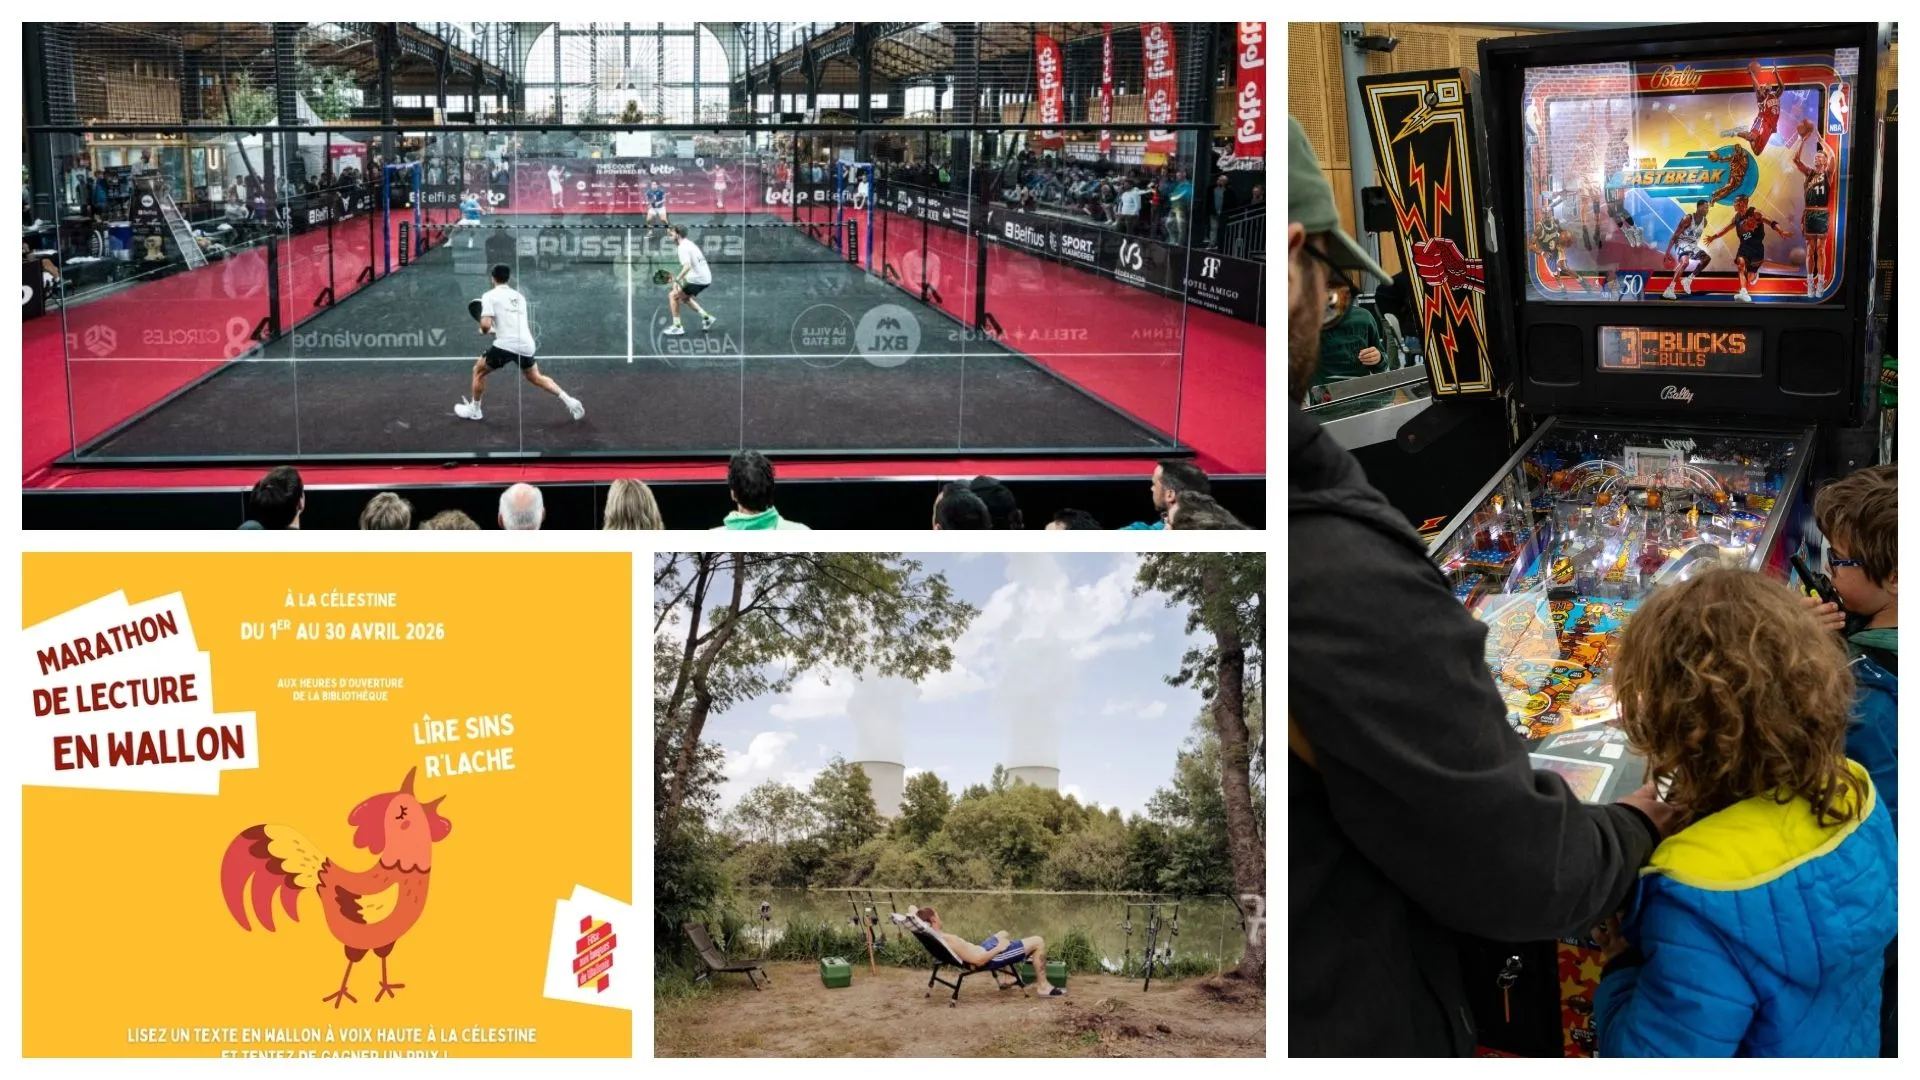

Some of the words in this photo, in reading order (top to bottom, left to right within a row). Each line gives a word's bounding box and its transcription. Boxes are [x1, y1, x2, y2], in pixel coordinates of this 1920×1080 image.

[1651, 64, 1702, 93] Bally
[1829, 124, 1842, 132] NBA
[1622, 169, 1726, 185] FASTBREAK
[1814, 186, 1826, 195] 11
[1014, 223, 1044, 248] Belfius
[1210, 285, 1239, 299] AMIGO
[1620, 274, 1643, 296] 50
[1659, 332, 1746, 354] BUCKS
[1659, 352, 1706, 367] BULLS
[1660, 385, 1694, 404] Bally
[285, 588, 294, 607] À
[299, 593, 317, 607] LA
[320, 589, 397, 607] CÉLESTINE
[240, 622, 265, 640] DU
[296, 622, 320, 640] AU
[326, 622, 346, 640] 30
[350, 622, 400, 640] AVRIL
[406, 622, 445, 640] 2026
[36, 610, 179, 676] MARATHON
[277, 678, 297, 688] AUX
[300, 678, 337, 688] HEURES
[32, 686, 70, 717] DE
[76, 674, 198, 713] LECTURE
[292, 690, 306, 701] DE
[308, 690, 320, 701] LA
[322, 689, 388, 701] BIBLIOTHÈQUE
[414, 714, 460, 745] LÎRE
[465, 713, 515, 739] SINS
[54, 734, 100, 770] EN
[108, 724, 245, 767] WALLON
[424, 746, 516, 778] R'LACHE
[128, 1028, 167, 1042] LISEZ
[171, 1028, 190, 1042] UN
[194, 1028, 237, 1042] TEXTE
[242, 1028, 261, 1042] EN
[264, 1028, 321, 1042] WALLON
[325, 1024, 335, 1042] À
[339, 1028, 372, 1042] VOIX
[377, 1028, 422, 1042] HAUTE
[427, 1024, 436, 1042] À
[440, 1028, 458, 1042] LA
[462, 1024, 537, 1042] CÉLESTINE
